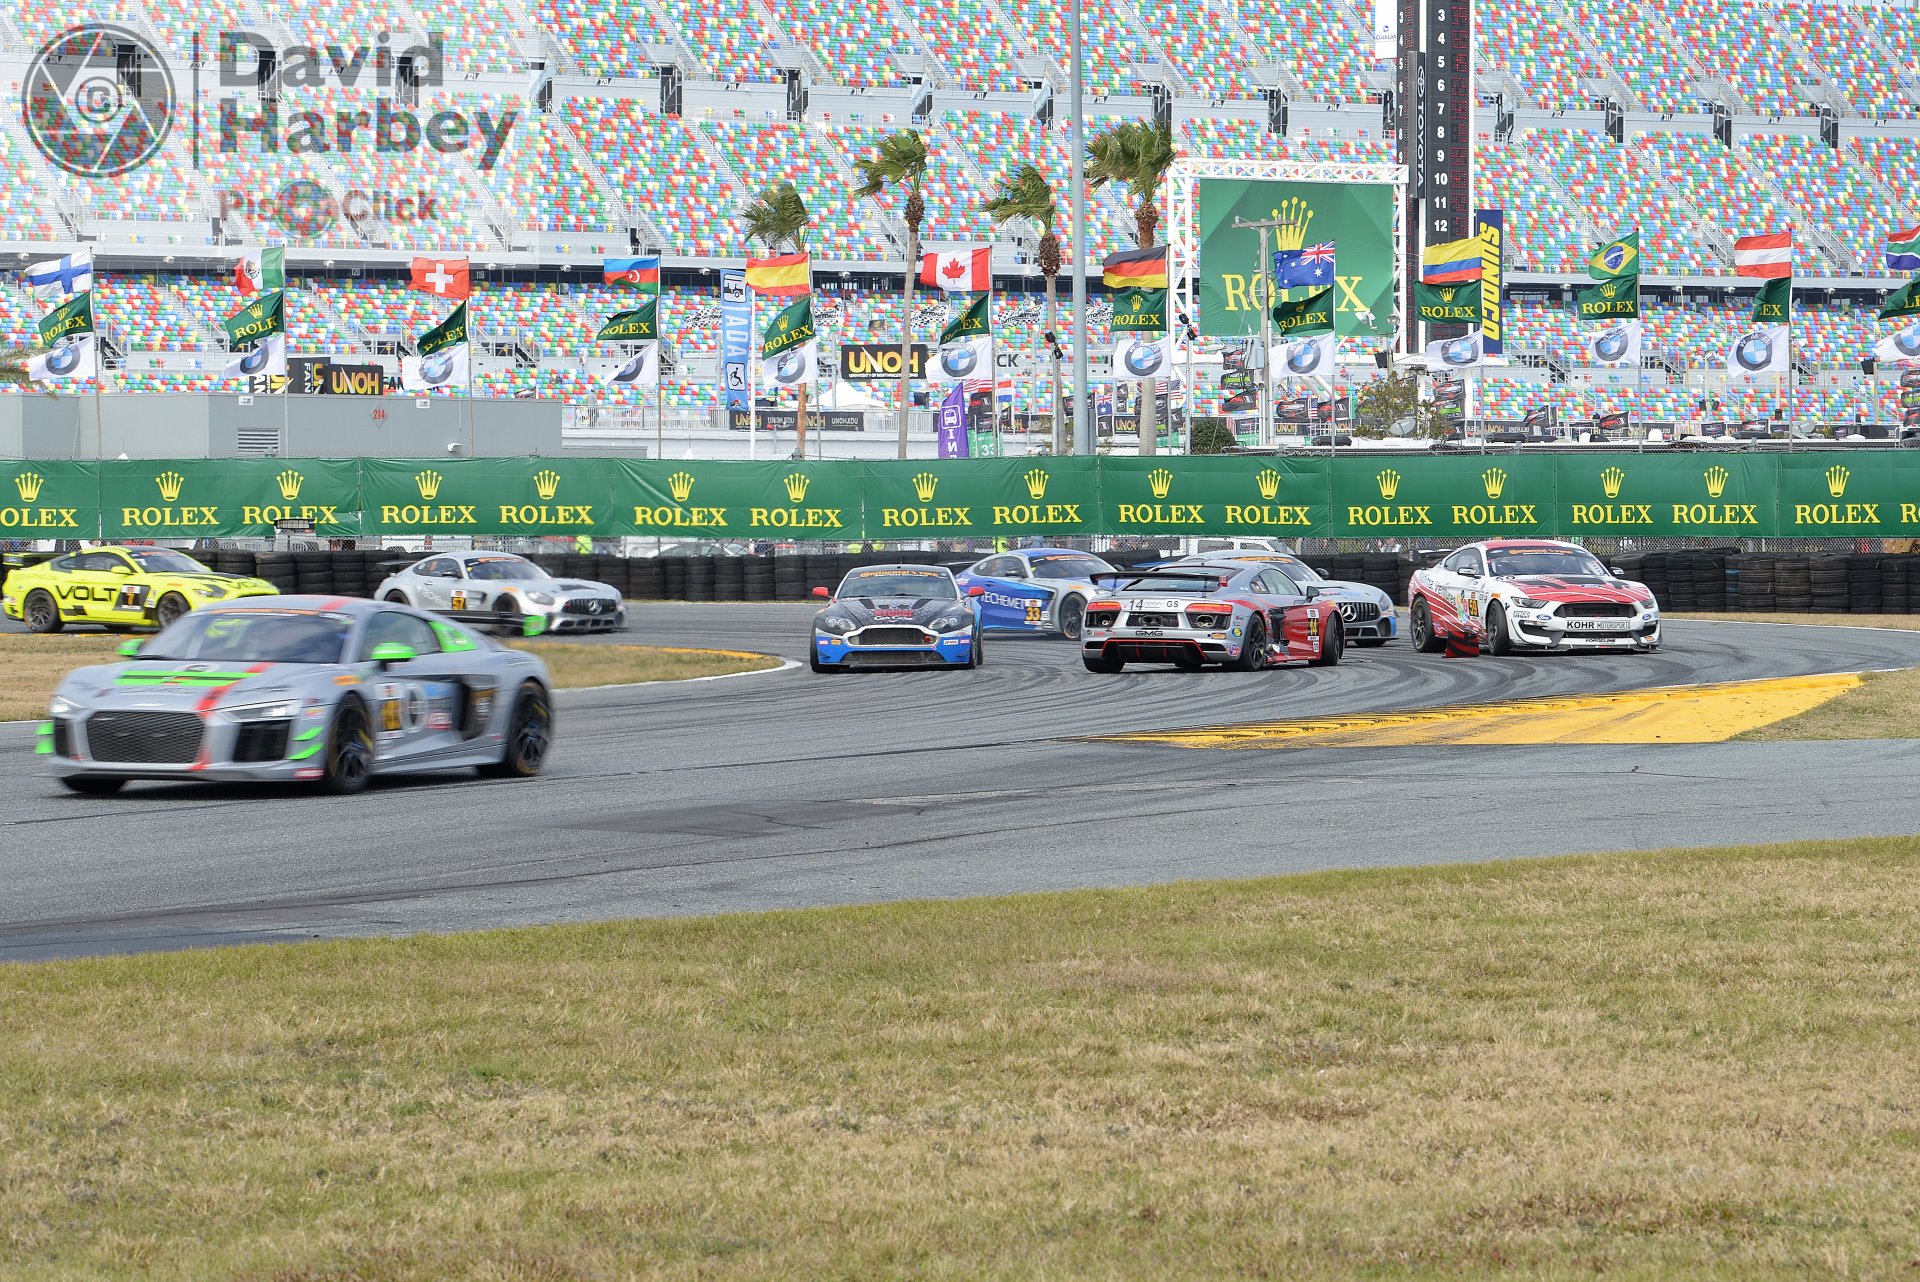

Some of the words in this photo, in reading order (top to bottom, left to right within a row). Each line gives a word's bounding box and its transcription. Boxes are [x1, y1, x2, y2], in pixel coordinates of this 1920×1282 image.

[1437, 9, 1446, 22] 3
[1437, 32, 1446, 45] 4
[1437, 55, 1446, 68] 5
[1437, 78, 1446, 92] 6
[1437, 102, 1445, 115] 7
[1436, 126, 1445, 139] 8
[1417, 101, 1426, 188] TOYOTA
[1436, 149, 1445, 162] 9
[1434, 172, 1448, 186] 10
[1434, 196, 1447, 209] 11
[1434, 219, 1448, 232] 12
[1480, 222, 1500, 341] SUNOCO
[1221, 273, 1371, 313] ROX
[1421, 306, 1476, 318] ROLEX
[1582, 300, 1635, 315] ROLEX
[43, 315, 87, 344] ROLEX
[1113, 313, 1161, 327] ROLEX
[1279, 311, 1329, 333] ROLEX
[725, 314, 749, 357] ADA
[763, 324, 813, 354] ROLEX
[848, 347, 919, 373] UNOH
[332, 367, 379, 394] UNOH
[373, 409, 385, 420] 214
[735, 412, 762, 427] UNH
[0, 508, 78, 527] OLEX
[122, 507, 219, 526] ROLEX
[242, 506, 339, 525] ROLEX
[381, 505, 477, 524] ROLEX
[499, 505, 594, 525] ROLEX
[634, 506, 728, 526] ROLEX
[750, 508, 843, 528] ROLEX
[882, 508, 972, 527] ROLEX
[993, 505, 1082, 524] ROLEX
[1118, 504, 1205, 524] ROLEX
[1225, 505, 1311, 525] ROLEX
[1348, 506, 1432, 526] ROLEX
[1452, 505, 1537, 524] ROLEX
[1572, 504, 1653, 524] ROLEX
[1672, 504, 1758, 524] ROLEX
[1795, 504, 1880, 524] ROLEX
[55, 584, 118, 602] VOLT
[1025, 606, 1041, 621] 33
[1129, 599, 1144, 611] 14
[1166, 600, 1179, 608] GS
[1469, 599, 1478, 617] 59
[1566, 621, 1595, 629] KOHR
[1596, 621, 1631, 629] MOTORSPORTS
